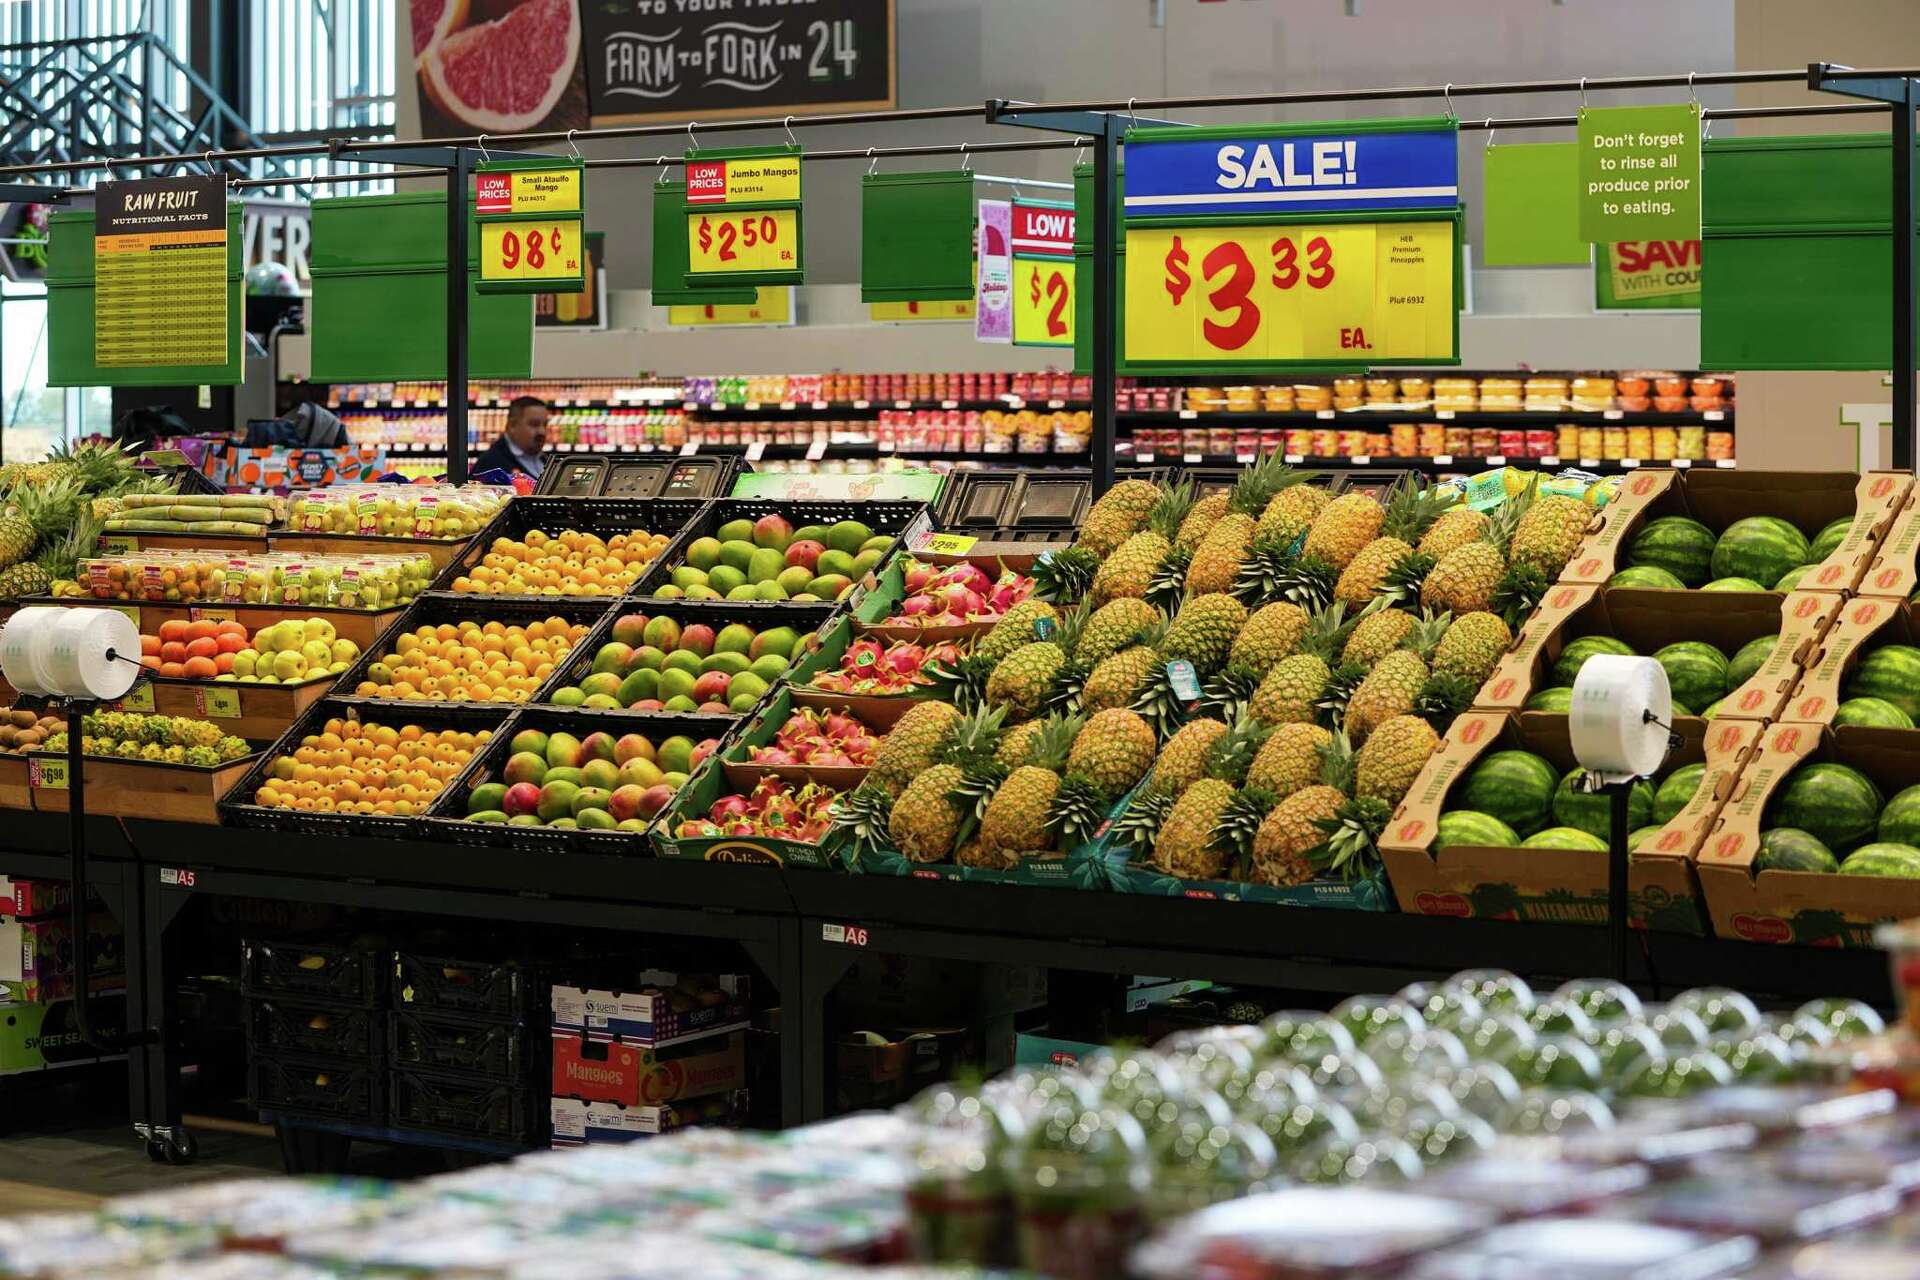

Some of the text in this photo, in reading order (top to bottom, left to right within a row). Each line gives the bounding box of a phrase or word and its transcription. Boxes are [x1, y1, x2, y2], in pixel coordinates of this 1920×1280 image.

[637, 3, 667, 15] TO
[677, 0, 734, 13] YOUR
[605, 19, 858, 87] FARM TO FORK IN 24
[1638, 132, 1685, 149] forget
[1215, 139, 1358, 190] SALE!
[1600, 154, 1678, 171] to rinse all
[522, 176, 543, 184] Small
[694, 168, 718, 179] LOW
[731, 167, 798, 178] Jumbo Mangos
[484, 180, 505, 189] LOW
[534, 184, 559, 192] Mango
[689, 178, 724, 189] PRICES
[1588, 176, 1691, 195] produce prior
[124, 190, 199, 212] RAW FRUIT
[479, 189, 510, 199] PRICES
[1603, 199, 1676, 216] to eating.
[112, 213, 209, 225] NUTRITIONAL FACTS
[1026, 212, 1067, 237] LOW
[1390, 256, 1425, 264] Pineapples
[1621, 272, 1700, 290] WITH COU
[1340, 326, 1373, 350] EA.
[176, 869, 196, 887] A5
[845, 927, 868, 947] A6
[24, 1033, 65, 1049] SWEET
[566, 1060, 625, 1086] Mangoes
